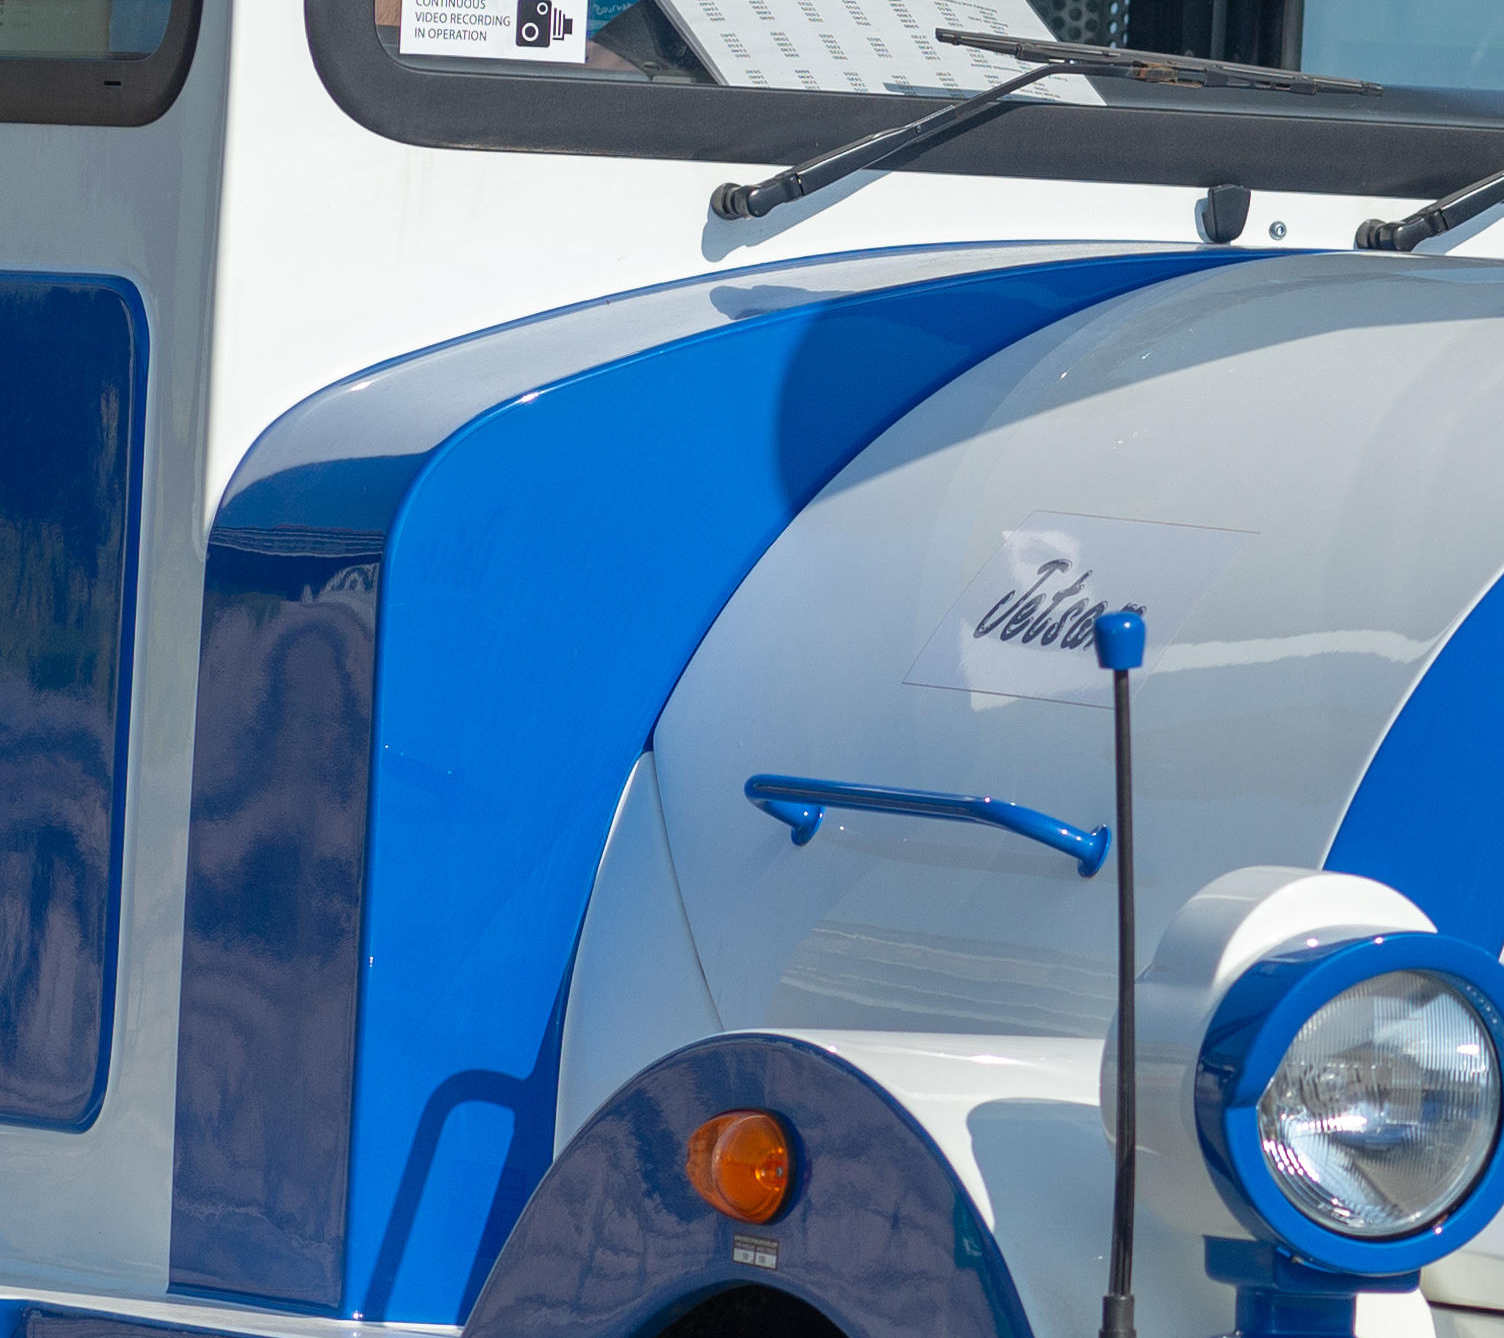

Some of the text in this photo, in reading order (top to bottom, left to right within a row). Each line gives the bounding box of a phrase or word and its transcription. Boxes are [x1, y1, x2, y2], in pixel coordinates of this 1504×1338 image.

[416, 13, 511, 27] VIDEO RECORDING
[415, 28, 487, 41] IN OPERATION
